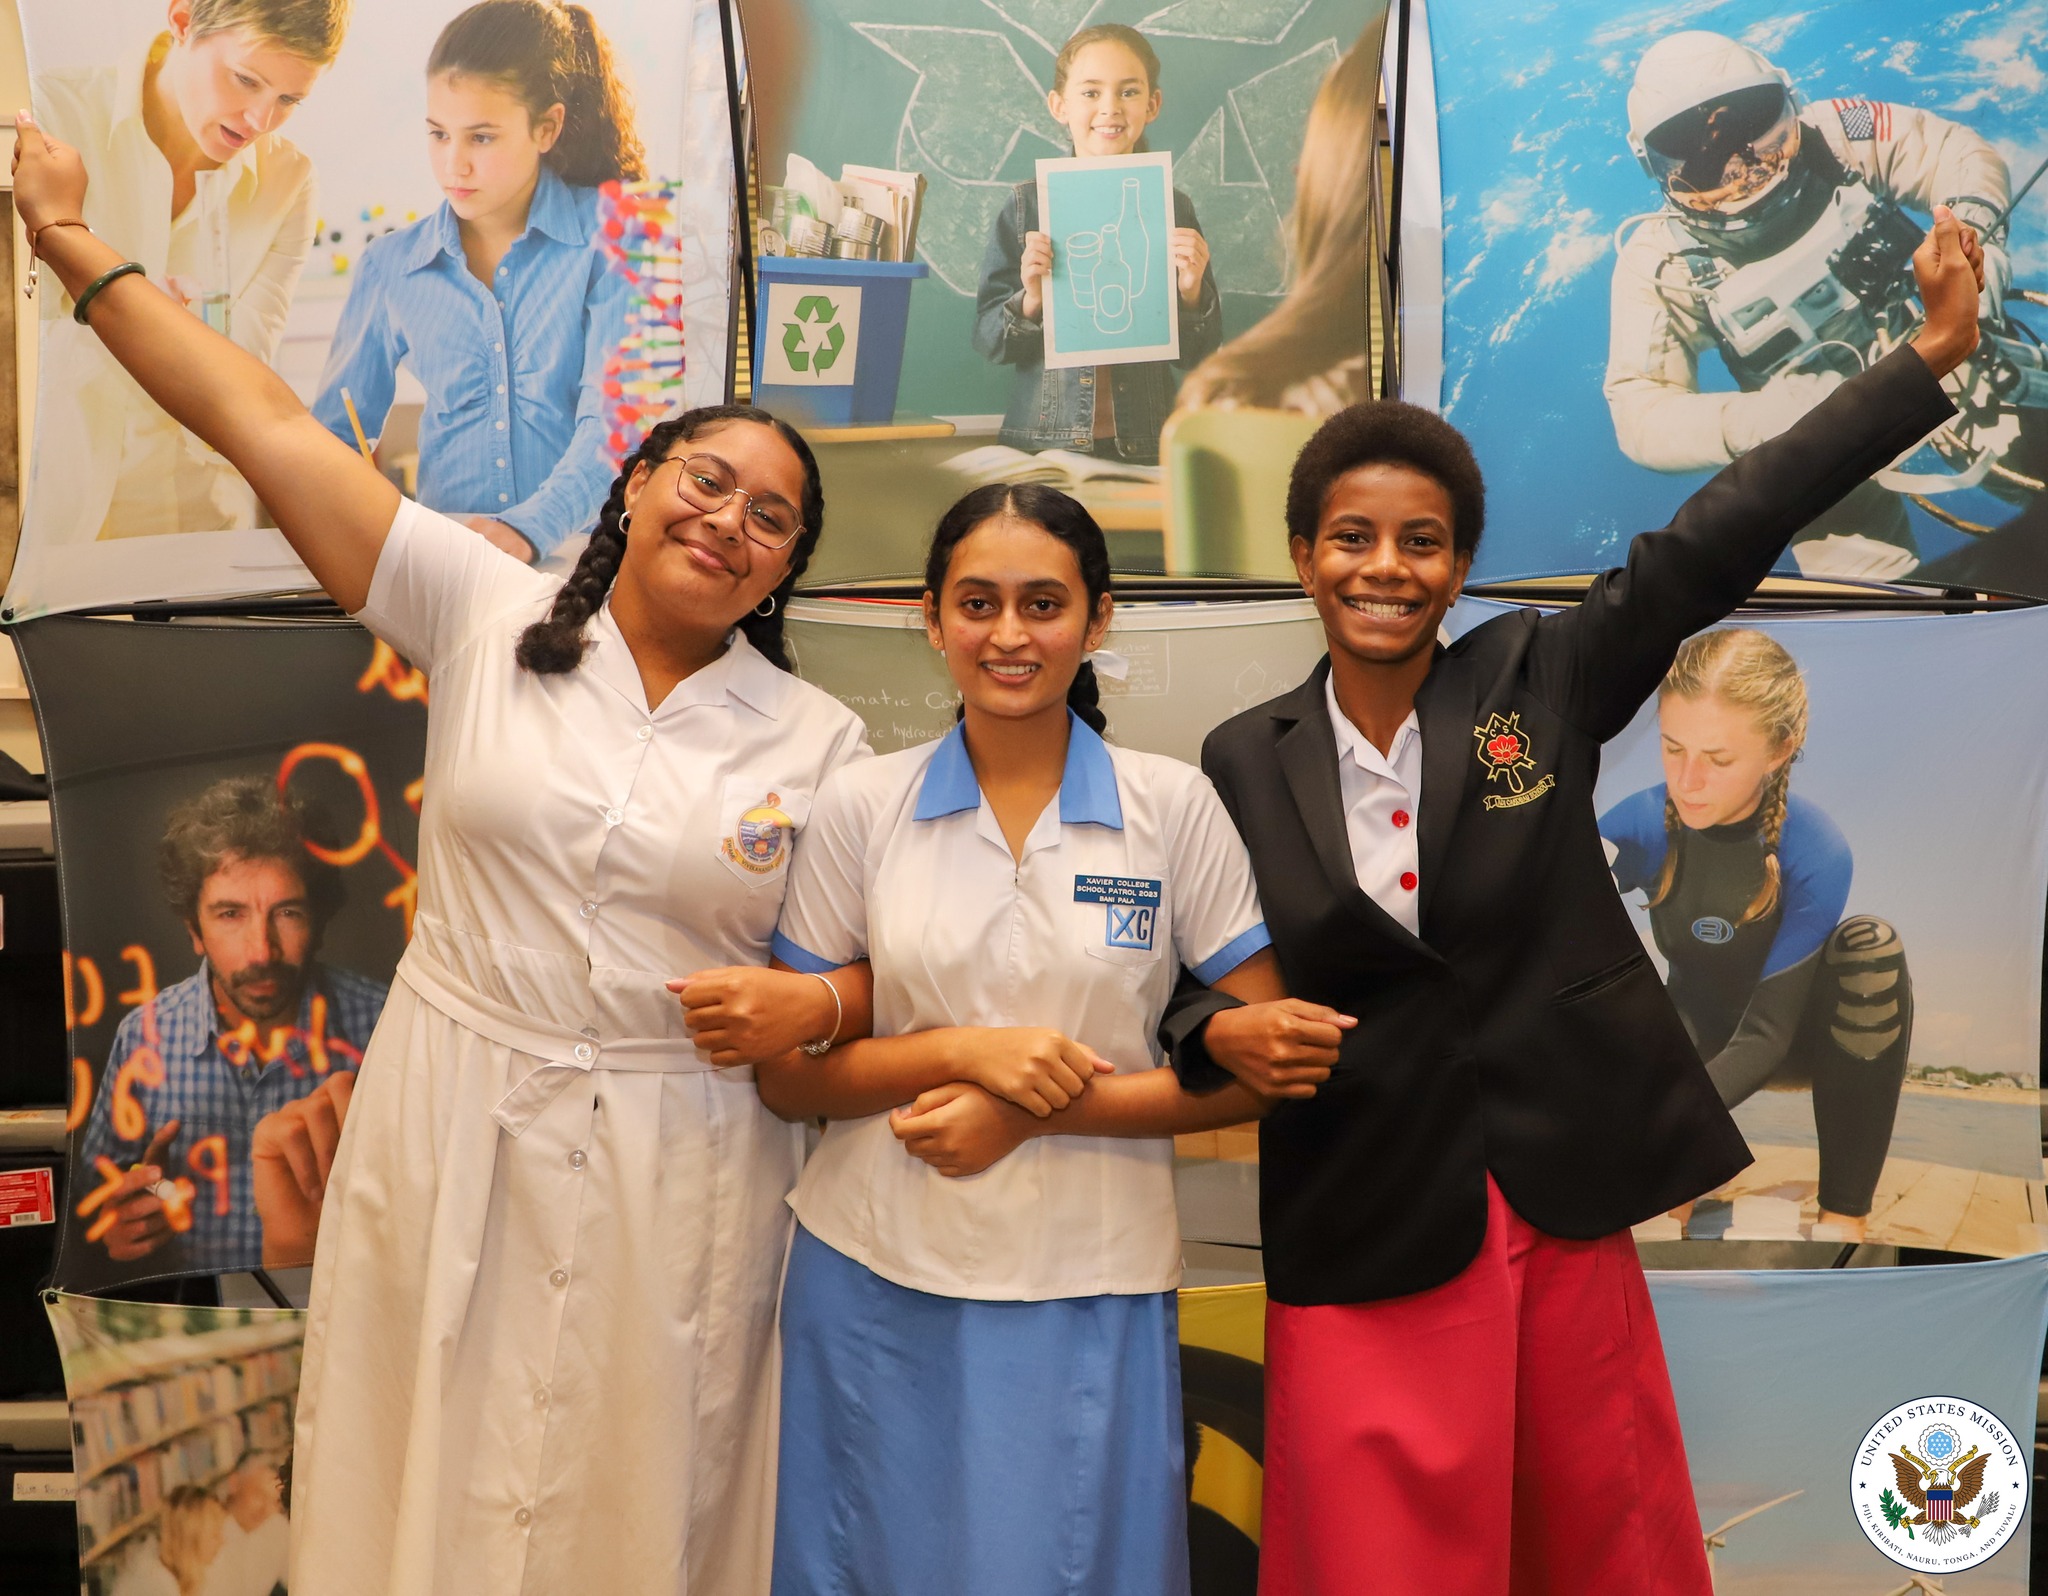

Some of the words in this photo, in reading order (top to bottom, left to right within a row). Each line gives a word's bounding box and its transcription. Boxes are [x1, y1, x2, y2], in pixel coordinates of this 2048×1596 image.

[1086, 878, 1114, 886] XAVIER
[1116, 880, 1150, 889] COLLEGE
[1076, 885, 1107, 894] SCHOOL
[1108, 887, 1137, 896] PATROL
[1138, 890, 1158, 898] 2023
